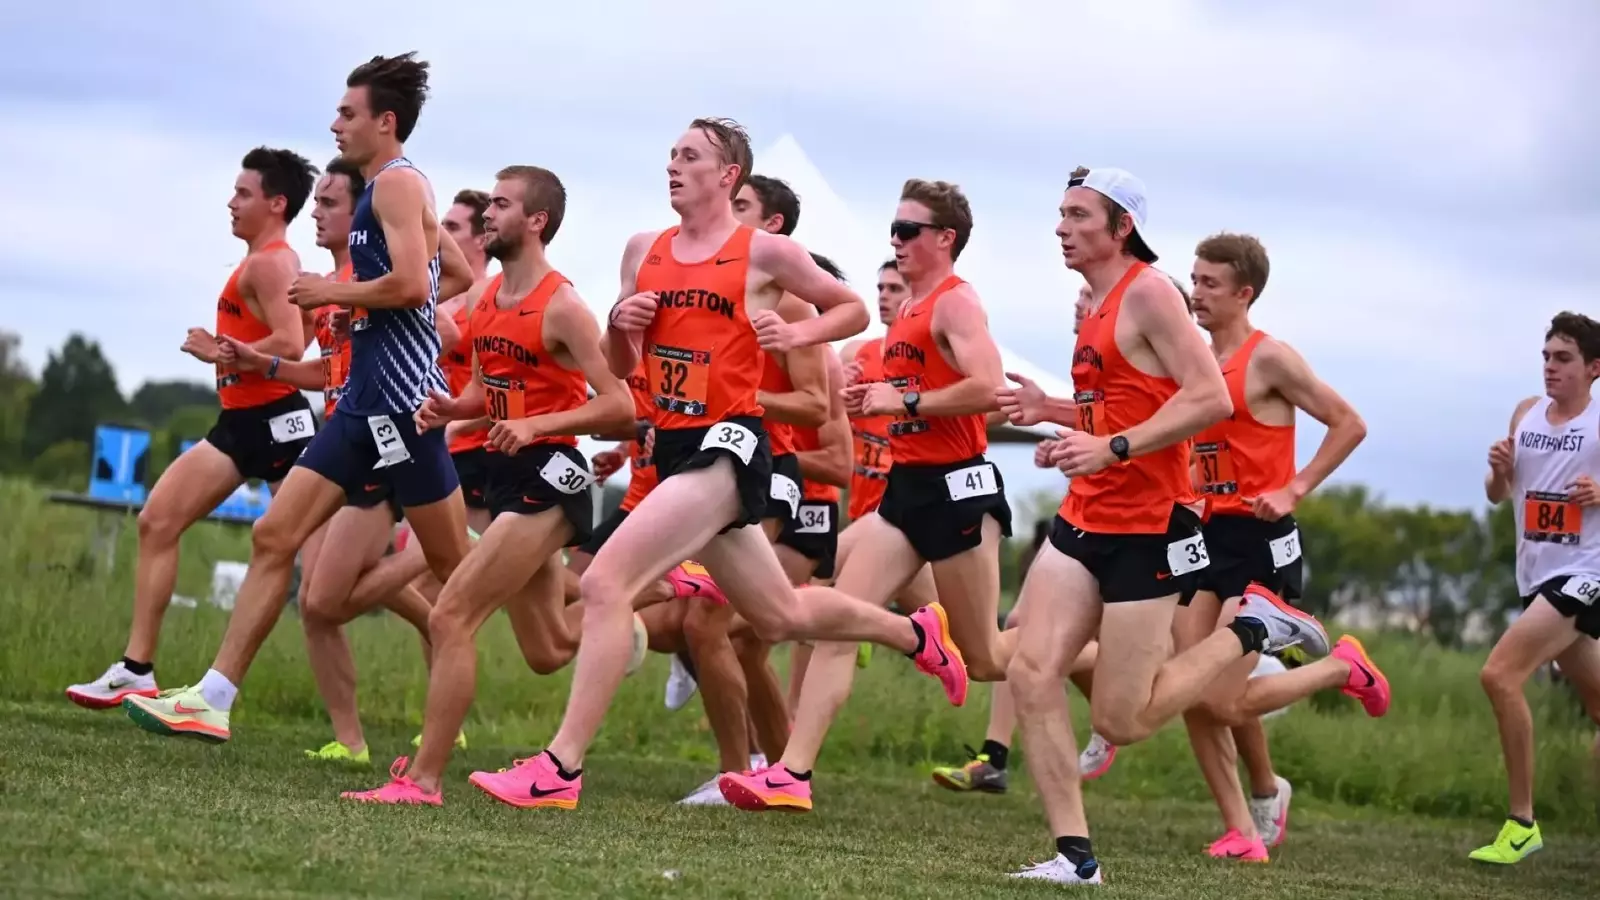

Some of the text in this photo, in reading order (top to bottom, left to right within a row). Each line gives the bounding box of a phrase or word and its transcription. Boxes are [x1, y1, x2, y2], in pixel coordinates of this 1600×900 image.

[661, 360, 688, 398] 32
[487, 388, 508, 420] 30
[286, 416, 305, 435] 35
[377, 424, 397, 448] 13
[718, 426, 745, 449] 32
[1519, 431, 1585, 452] NORTHWEST
[558, 467, 586, 491] 30
[1200, 454, 1218, 483] 37
[965, 471, 984, 490] 41
[805, 511, 825, 527] 34
[1537, 503, 1564, 531] 84
[1185, 539, 1208, 564] 33
[1284, 538, 1295, 558] 37
[1577, 582, 1599, 600] 84
